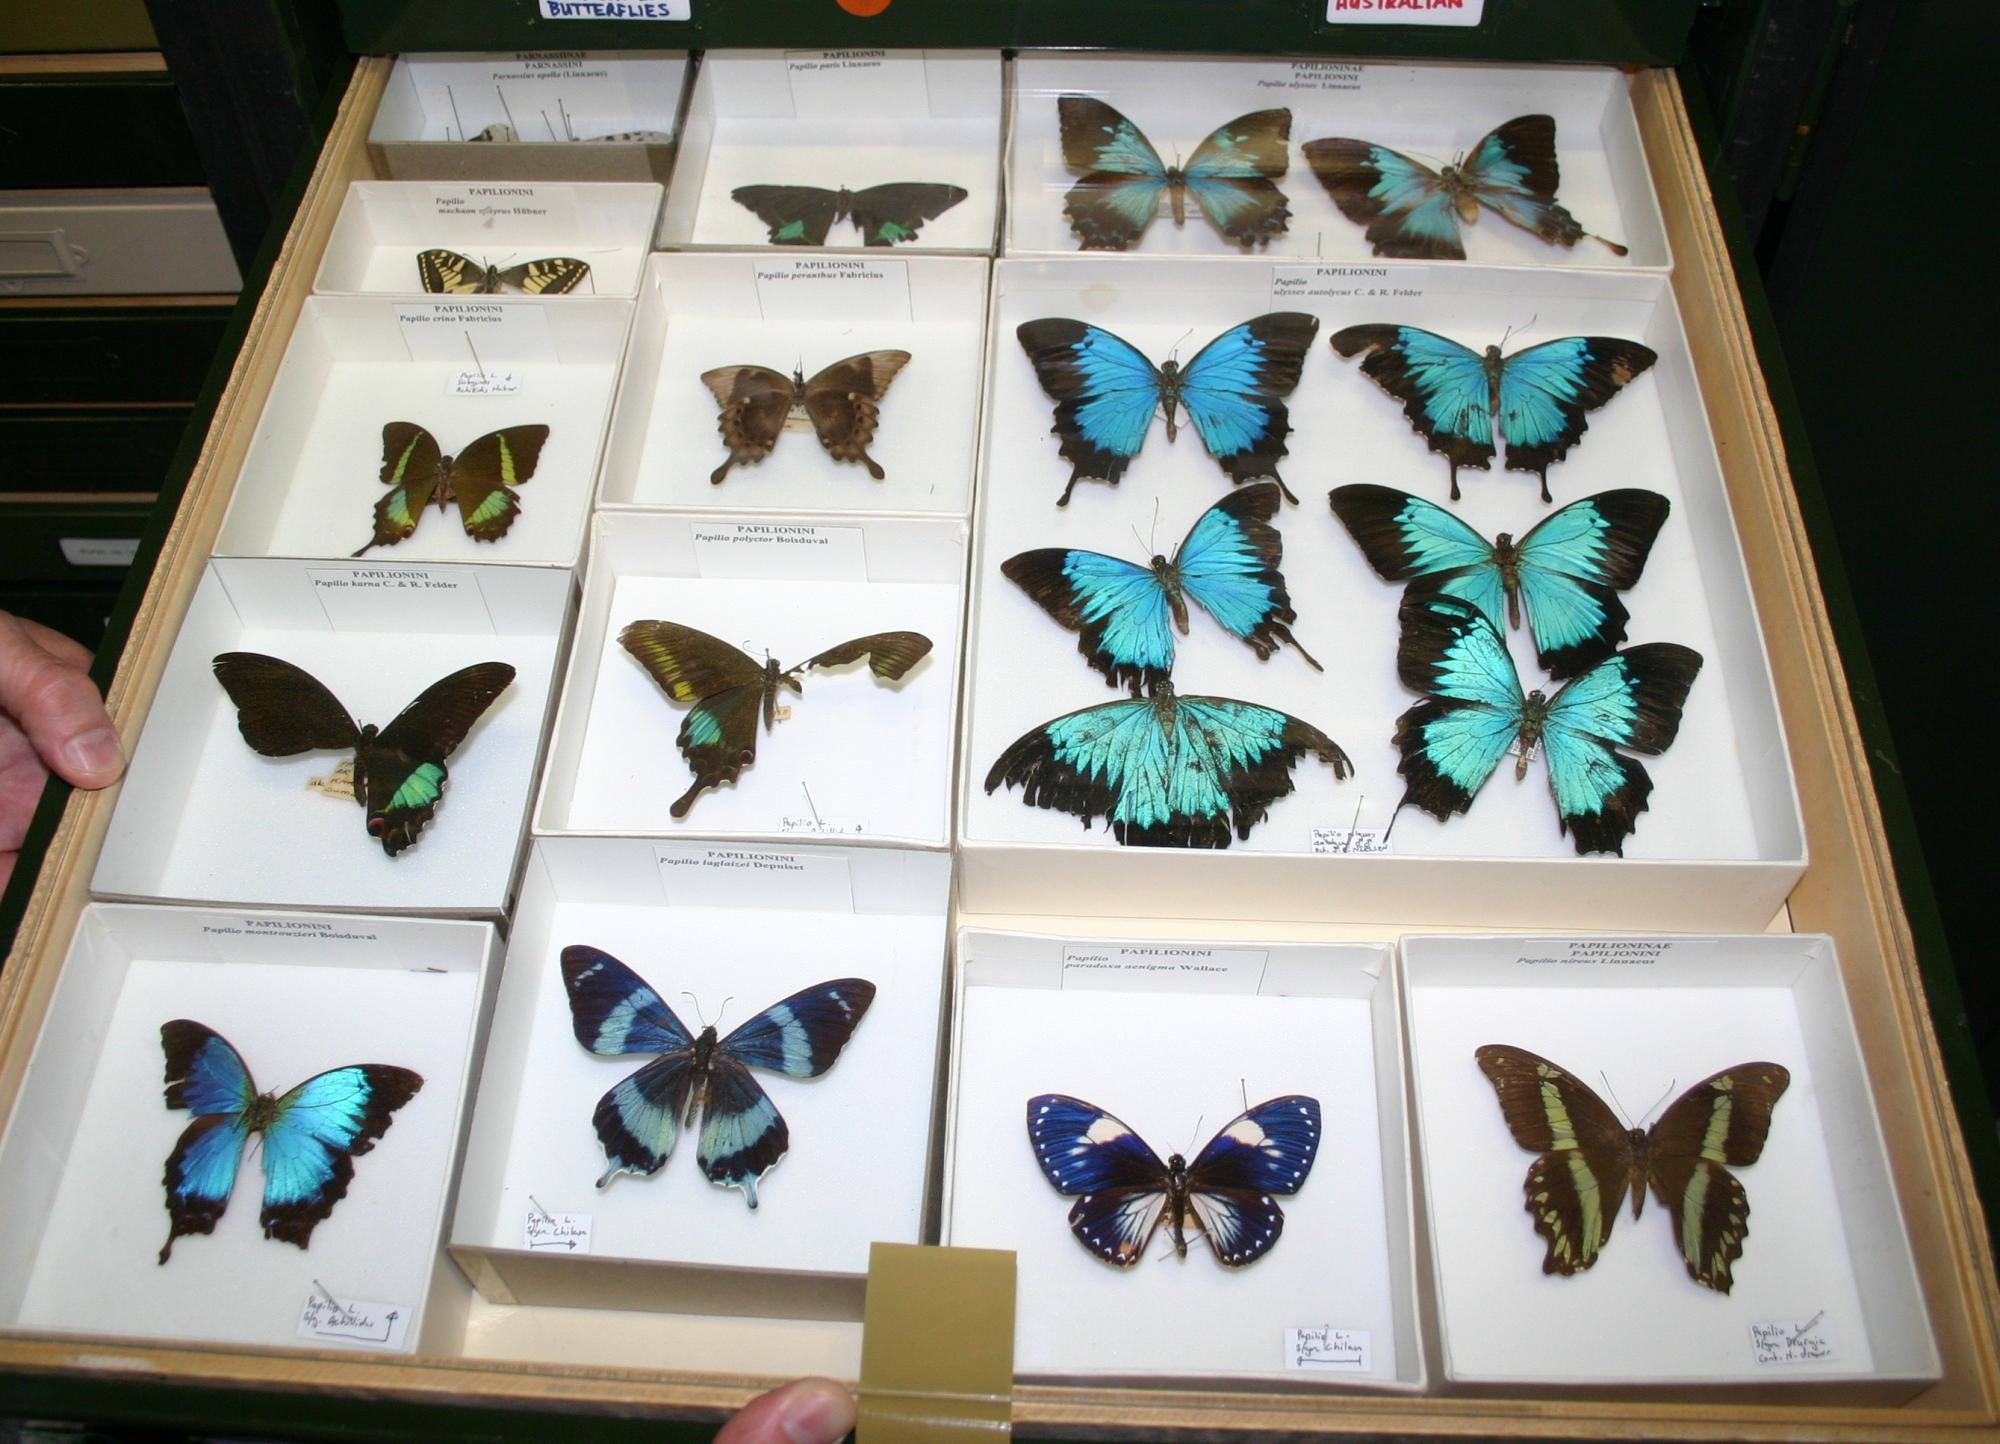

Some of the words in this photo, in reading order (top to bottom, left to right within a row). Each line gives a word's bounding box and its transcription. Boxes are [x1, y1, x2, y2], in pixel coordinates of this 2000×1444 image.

[549, 1, 670, 17] BUTTERFLIES
[1336, 0, 1463, 10] AUSTRALIAN
[823, 50, 886, 59] PAPILIONINI
[525, 60, 583, 69] PARNASSINI
[789, 62, 818, 71] Papilio
[819, 61, 840, 70] paris
[842, 60, 881, 68] Linnaeus
[1291, 62, 1363, 72] PAPILIONINAE
[537, 71, 561, 80] apollo
[1295, 72, 1359, 81] PAPILIONINI
[1257, 80, 1287, 88] Papilio
[1288, 81, 1317, 90] ulysses
[1322, 82, 1361, 90] Linnaeus
[468, 188, 534, 196] PAPILIONINI
[436, 198, 465, 206] Papilio
[795, 261, 865, 269] PAPILIONINI
[757, 272, 790, 280] Papilio
[791, 272, 837, 281] peranthus
[839, 271, 884, 279] Fabricius
[1316, 268, 1387, 276] PAPILIONINI
[1275, 278, 1308, 286] Papilio
[1273, 288, 1306, 296] ulysses
[1307, 287, 1351, 297] autolycus
[1353, 288, 1365, 296] C.
[1367, 288, 1376, 297] &
[1379, 288, 1390, 297] R.
[1393, 288, 1424, 297] Felder
[434, 305, 503, 313] PAPILIONINI
[400, 315, 431, 324] Papilio
[737, 526, 815, 535] PAPILIONINI
[695, 533, 730, 543] Papilio
[732, 535, 773, 544] polyctor
[776, 536, 829, 545] Boisduval
[352, 571, 429, 579] PAPILIONINI
[314, 580, 349, 588] Papilio
[351, 580, 380, 588] karna
[382, 580, 395, 588] C.
[425, 581, 458, 589] Felder
[708, 851, 796, 862] PAPILIONINI
[660, 857, 700, 867] Papilio
[702, 859, 750, 868] laglaizei
[753, 862, 805, 871] Depuiset
[245, 920, 333, 931] PAPILIONINI
[202, 926, 243, 935] Papilio
[245, 929, 317, 938] montrouzieri
[319, 932, 377, 941] Boisduval
[1568, 942, 1673, 950] PAPILIONINAE
[1120, 948, 1213, 958] PAPILIONINI
[1066, 954, 1109, 963] Papilio
[1516, 957, 1558, 965] Papilio
[1560, 957, 1598, 965] nireus
[1064, 962, 1121, 970] paradoxa
[1124, 963, 1176, 972] aenigma
[1179, 964, 1229, 973] Wallace
